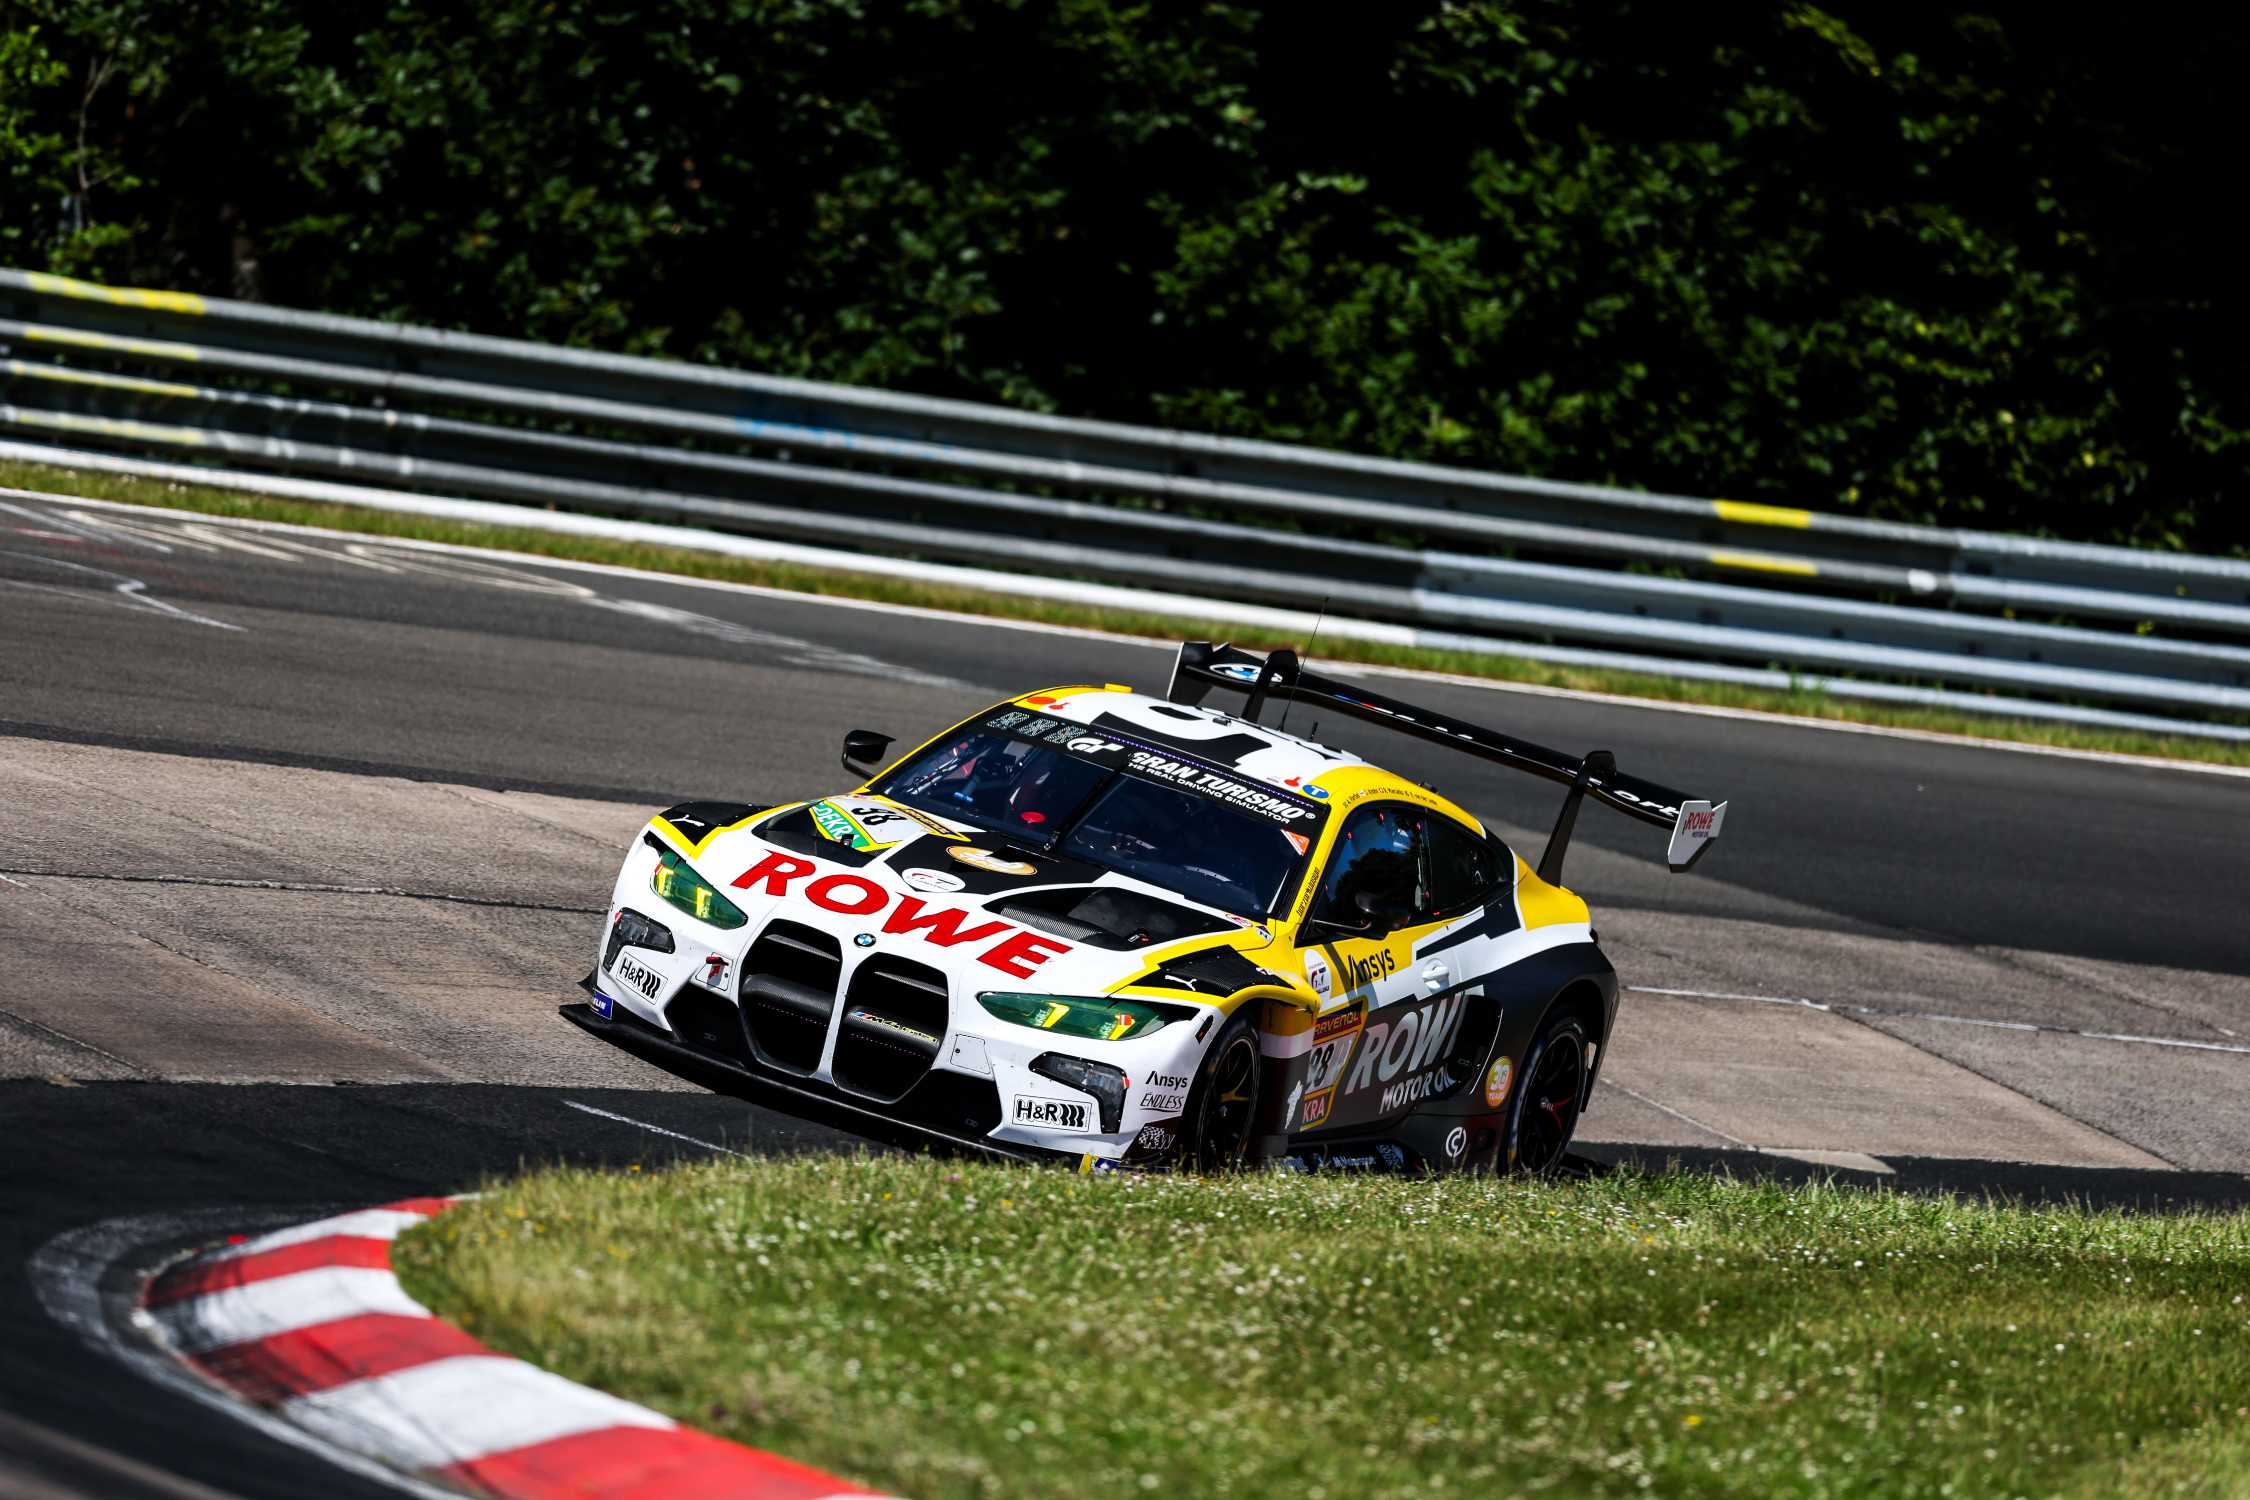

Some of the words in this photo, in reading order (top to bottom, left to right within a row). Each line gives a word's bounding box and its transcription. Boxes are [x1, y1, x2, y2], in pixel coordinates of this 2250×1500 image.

[1131, 752, 1200, 779] GRAN
[1146, 768, 1175, 782] REAL
[1177, 778, 1223, 799] DRIVING
[1224, 795, 1290, 824] SIMULATOR
[1686, 811, 1716, 830] ROWE
[730, 849, 1074, 980] ROWE
[619, 957, 645, 988] H&R
[1348, 948, 1395, 990] Ansys
[1145, 1071, 1188, 1091] Ansys
[1379, 1071, 1433, 1115] MOTOR
[1016, 1099, 1058, 1122] H&R
[1140, 1093, 1185, 1110] ENDLESS
[1302, 1096, 1326, 1123] KRA
